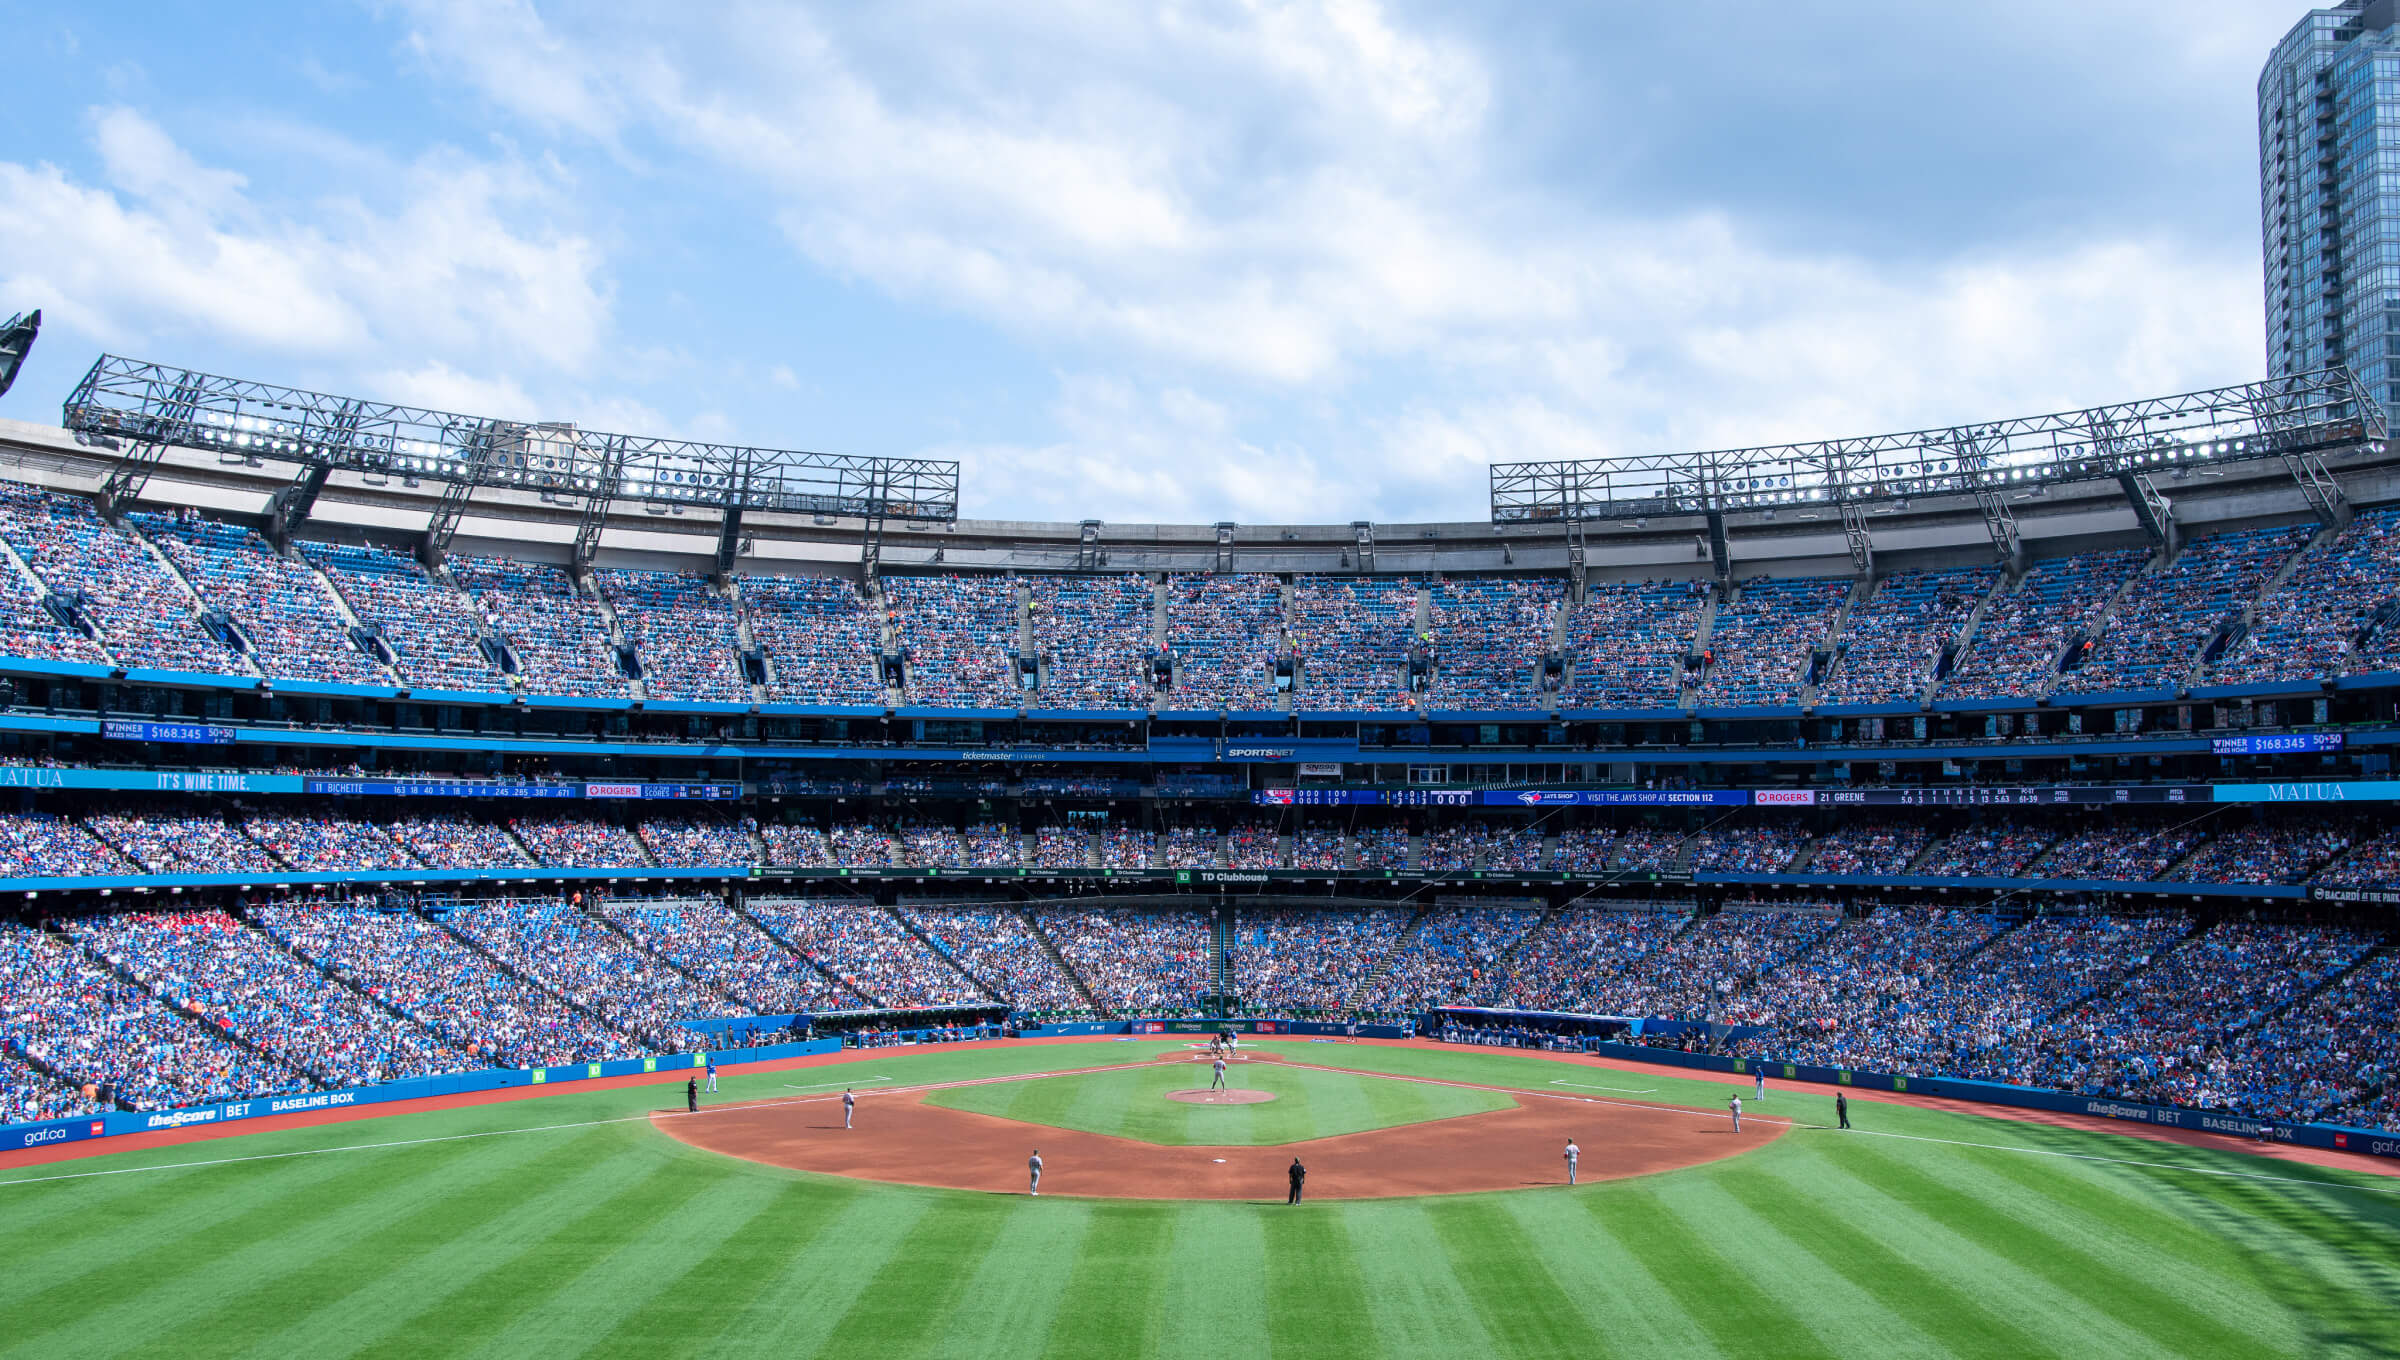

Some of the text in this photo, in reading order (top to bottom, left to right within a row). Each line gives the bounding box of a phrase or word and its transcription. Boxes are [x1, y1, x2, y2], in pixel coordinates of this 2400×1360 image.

[105, 722, 144, 733] WINNER
[2213, 738, 2248, 748] WINNER
[962, 751, 1012, 761] ticketmaster
[1228, 748, 1296, 757] SPORTSNET
[0, 768, 64, 786] ATUA
[157, 772, 250, 791] IT'S WINE TIME.
[315, 783, 363, 793] 11 BICHETTE
[394, 785, 406, 794] 163
[410, 786, 419, 794] 18
[424, 786, 434, 794] 40
[440, 786, 446, 795] 5
[453, 787, 461, 795] 18
[467, 787, 473, 796] 9
[600, 786, 638, 795] ROGERS
[2268, 783, 2345, 801] MATUA
[1438, 794, 1466, 804] 0 0 0
[1587, 793, 1714, 802] VISIT THE JAYS SHOP AT SECTION 112
[1769, 793, 1808, 802] ROGERS
[1820, 792, 1865, 802] 21 GREENE
[1901, 796, 1913, 804] 5.0
[1969, 796, 1975, 804] 5
[1982, 795, 1989, 803] 13
[1994, 795, 2010, 803] 5.63
[2018, 795, 2039, 803] 61-39
[1201, 872, 1269, 882] TD Clubhouse
[2361, 892, 2369, 900] AT
[2370, 892, 2381, 903] THE
[2382, 893, 2400, 903] PARK
[271, 1092, 355, 1112] BASELINE BOX
[147, 1103, 251, 1128] theScore BET
[2087, 1101, 2182, 1125] theScore BET
[24, 1128, 66, 1146] gaf.ca
